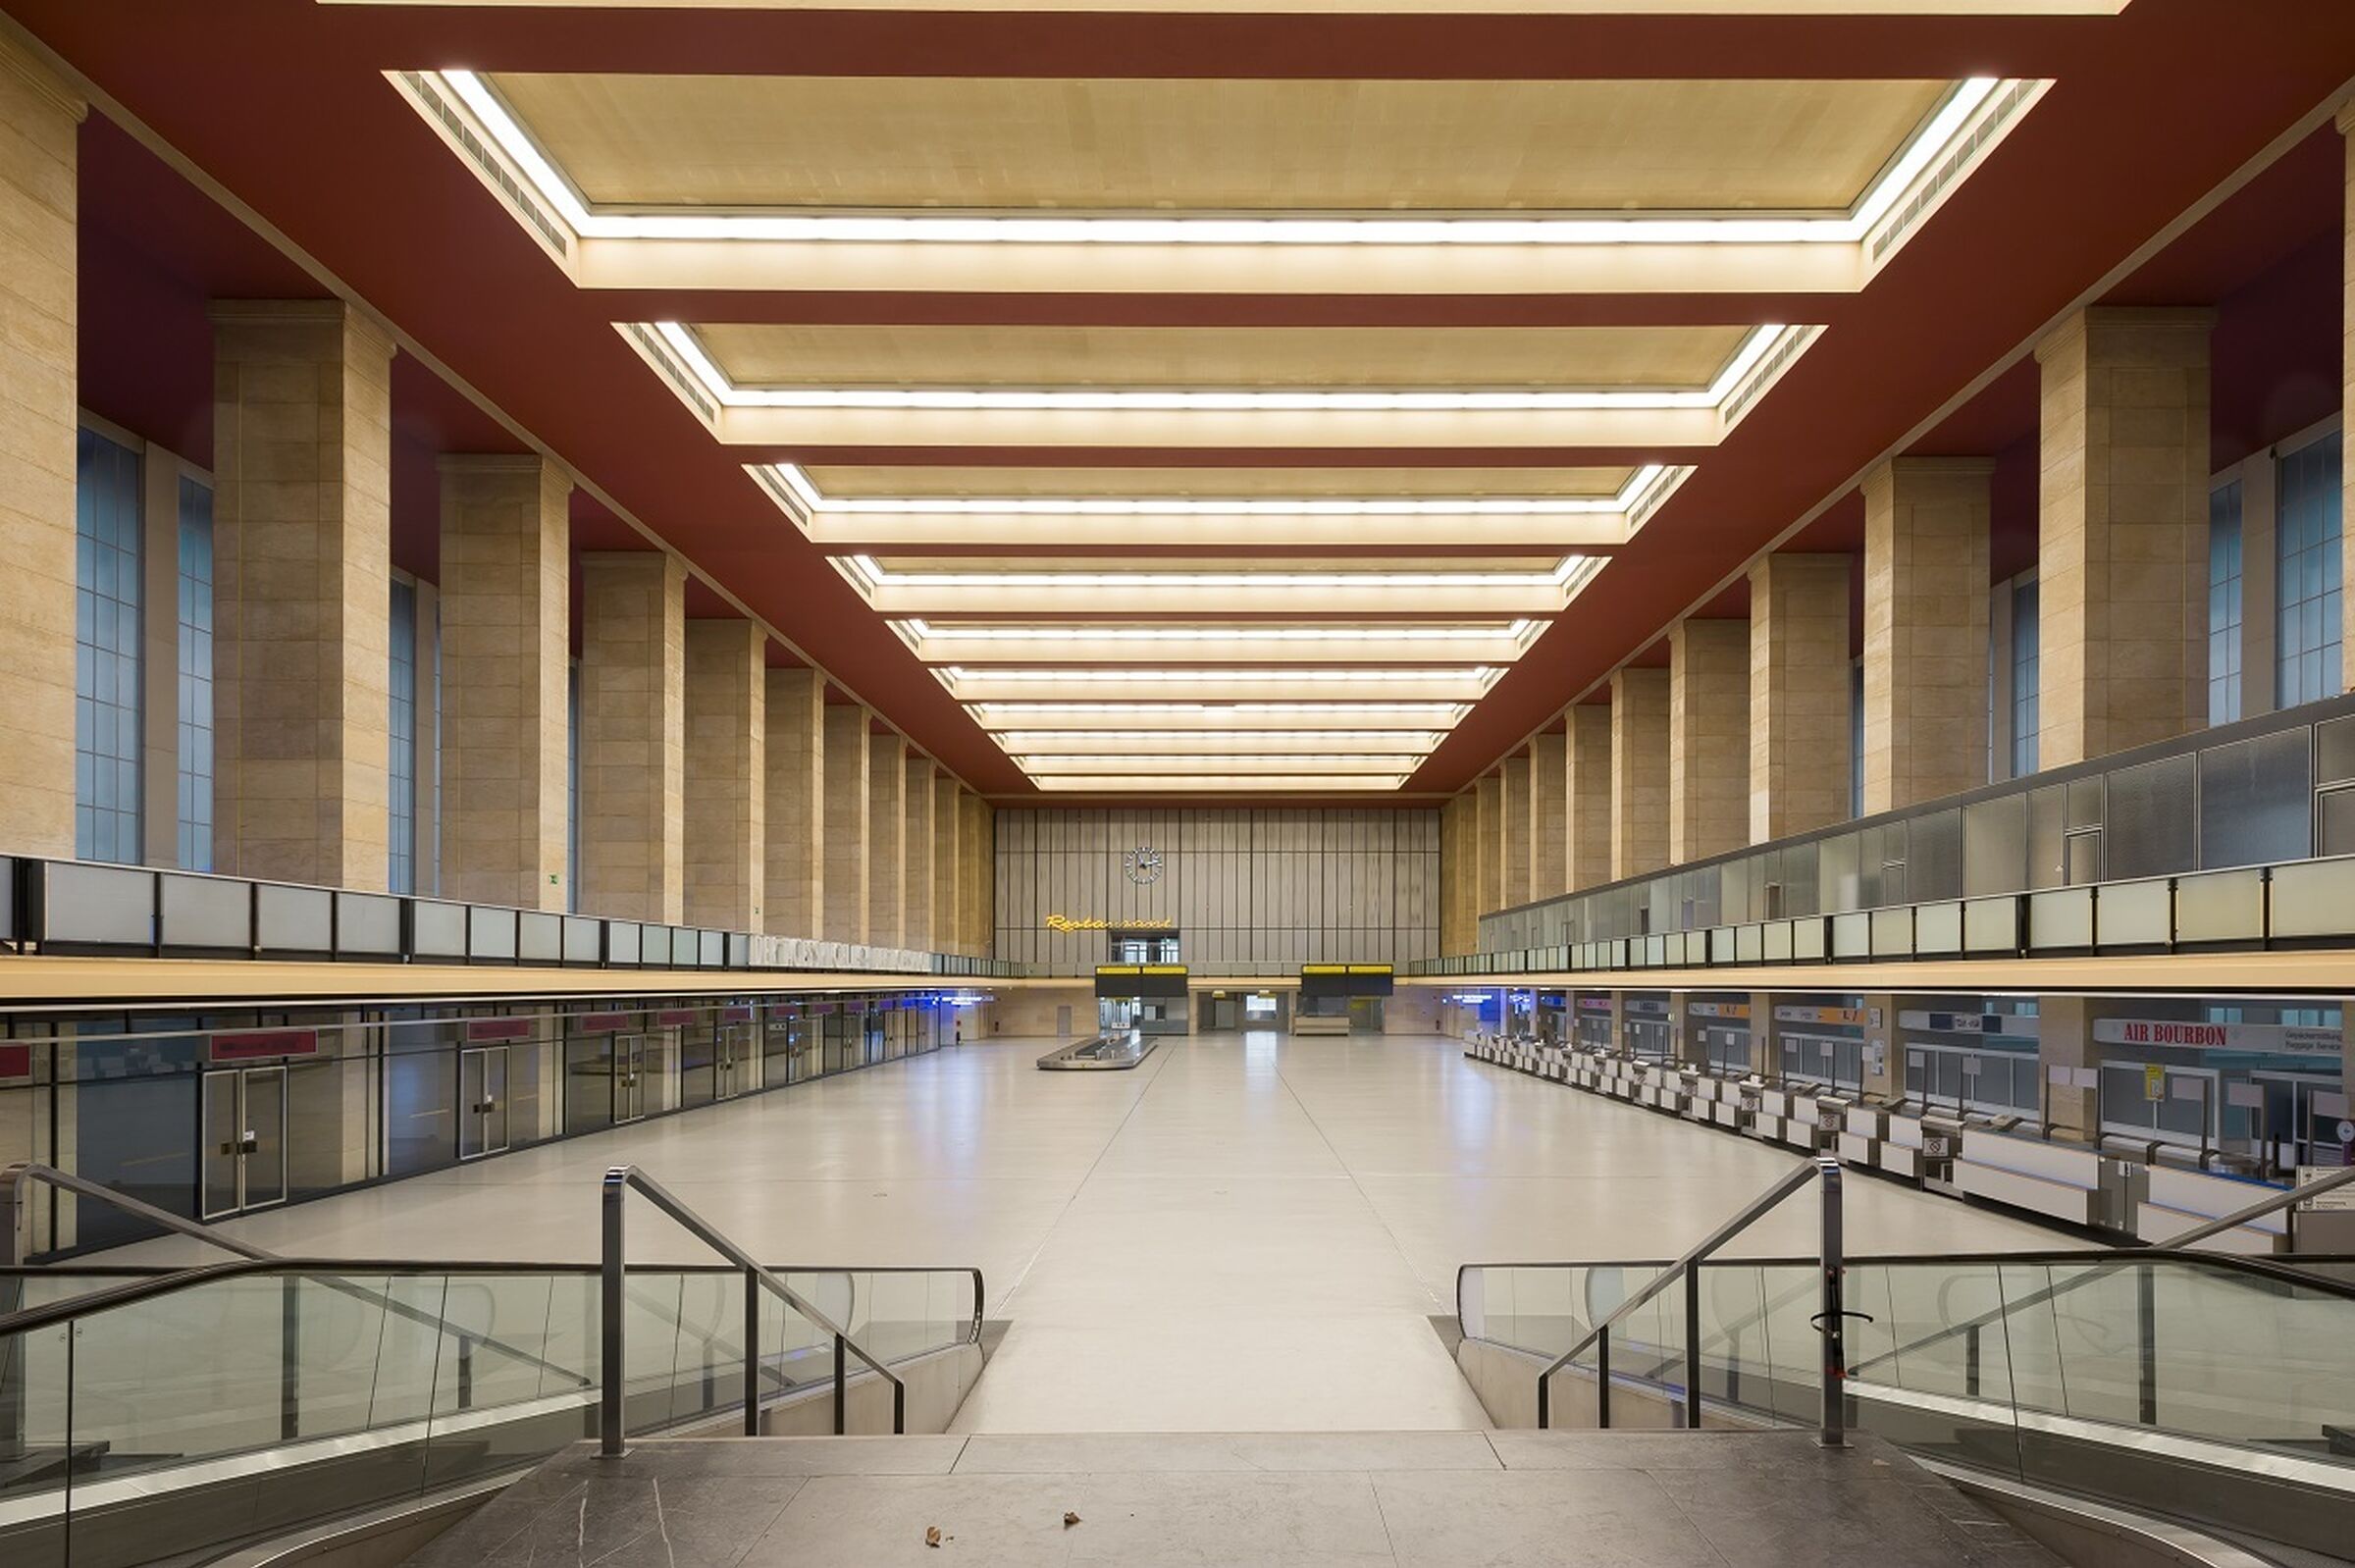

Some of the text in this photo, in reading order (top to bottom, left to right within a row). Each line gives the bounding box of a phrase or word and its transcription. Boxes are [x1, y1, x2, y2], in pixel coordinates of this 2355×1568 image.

[1046, 915, 1172, 933] Restaurant
[2124, 1023, 2226, 1046] AIR BOURBON
